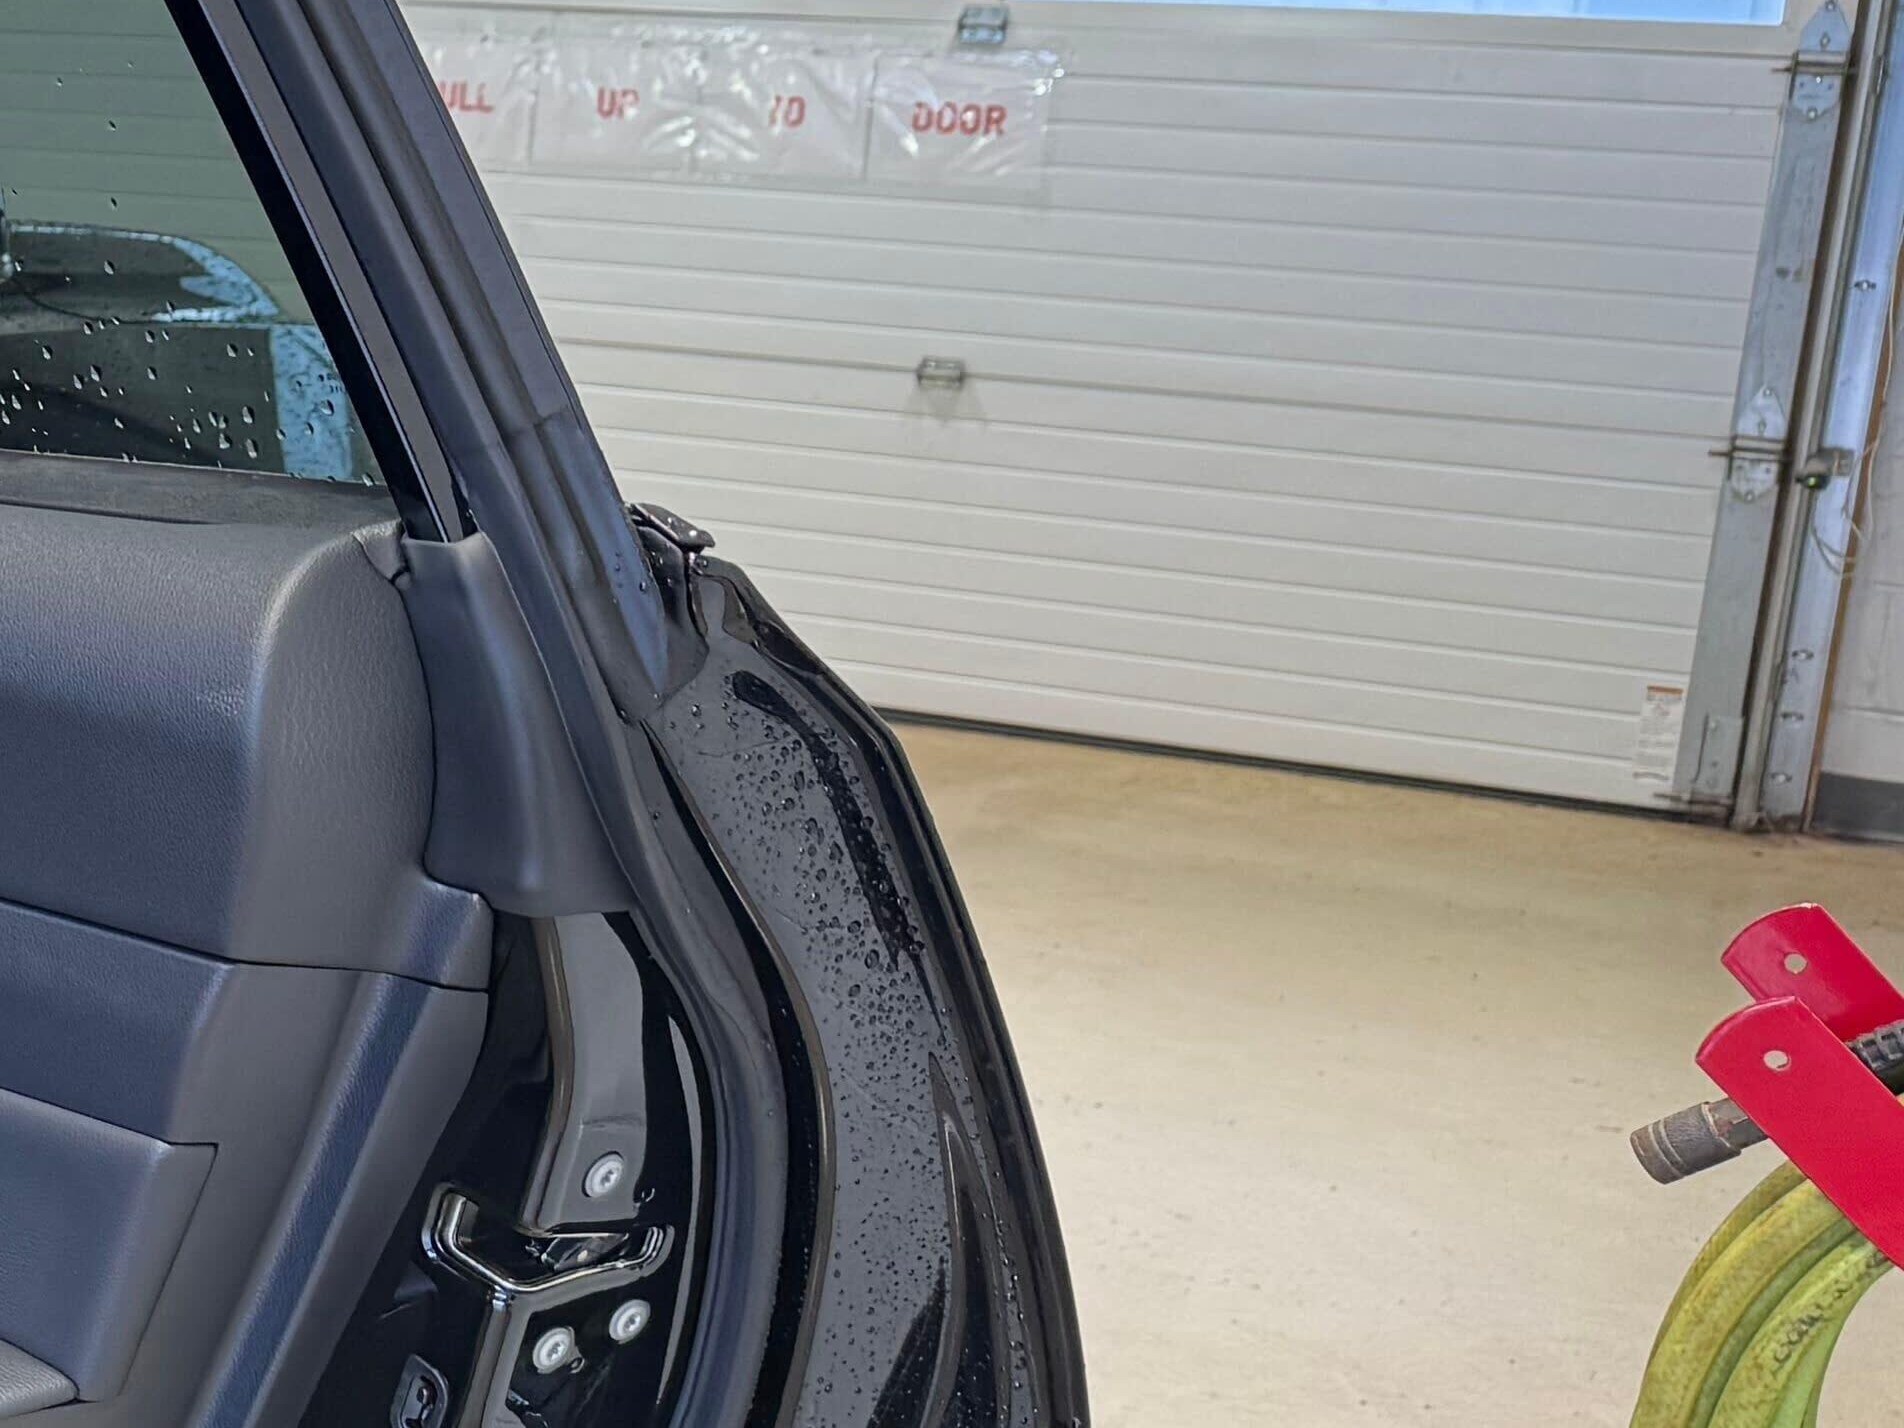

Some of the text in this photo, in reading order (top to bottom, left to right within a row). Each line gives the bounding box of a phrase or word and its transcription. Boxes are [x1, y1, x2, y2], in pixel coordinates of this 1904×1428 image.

[437, 80, 495, 113] ULL
[596, 86, 640, 119] UP
[910, 100, 1007, 136] DOOR
